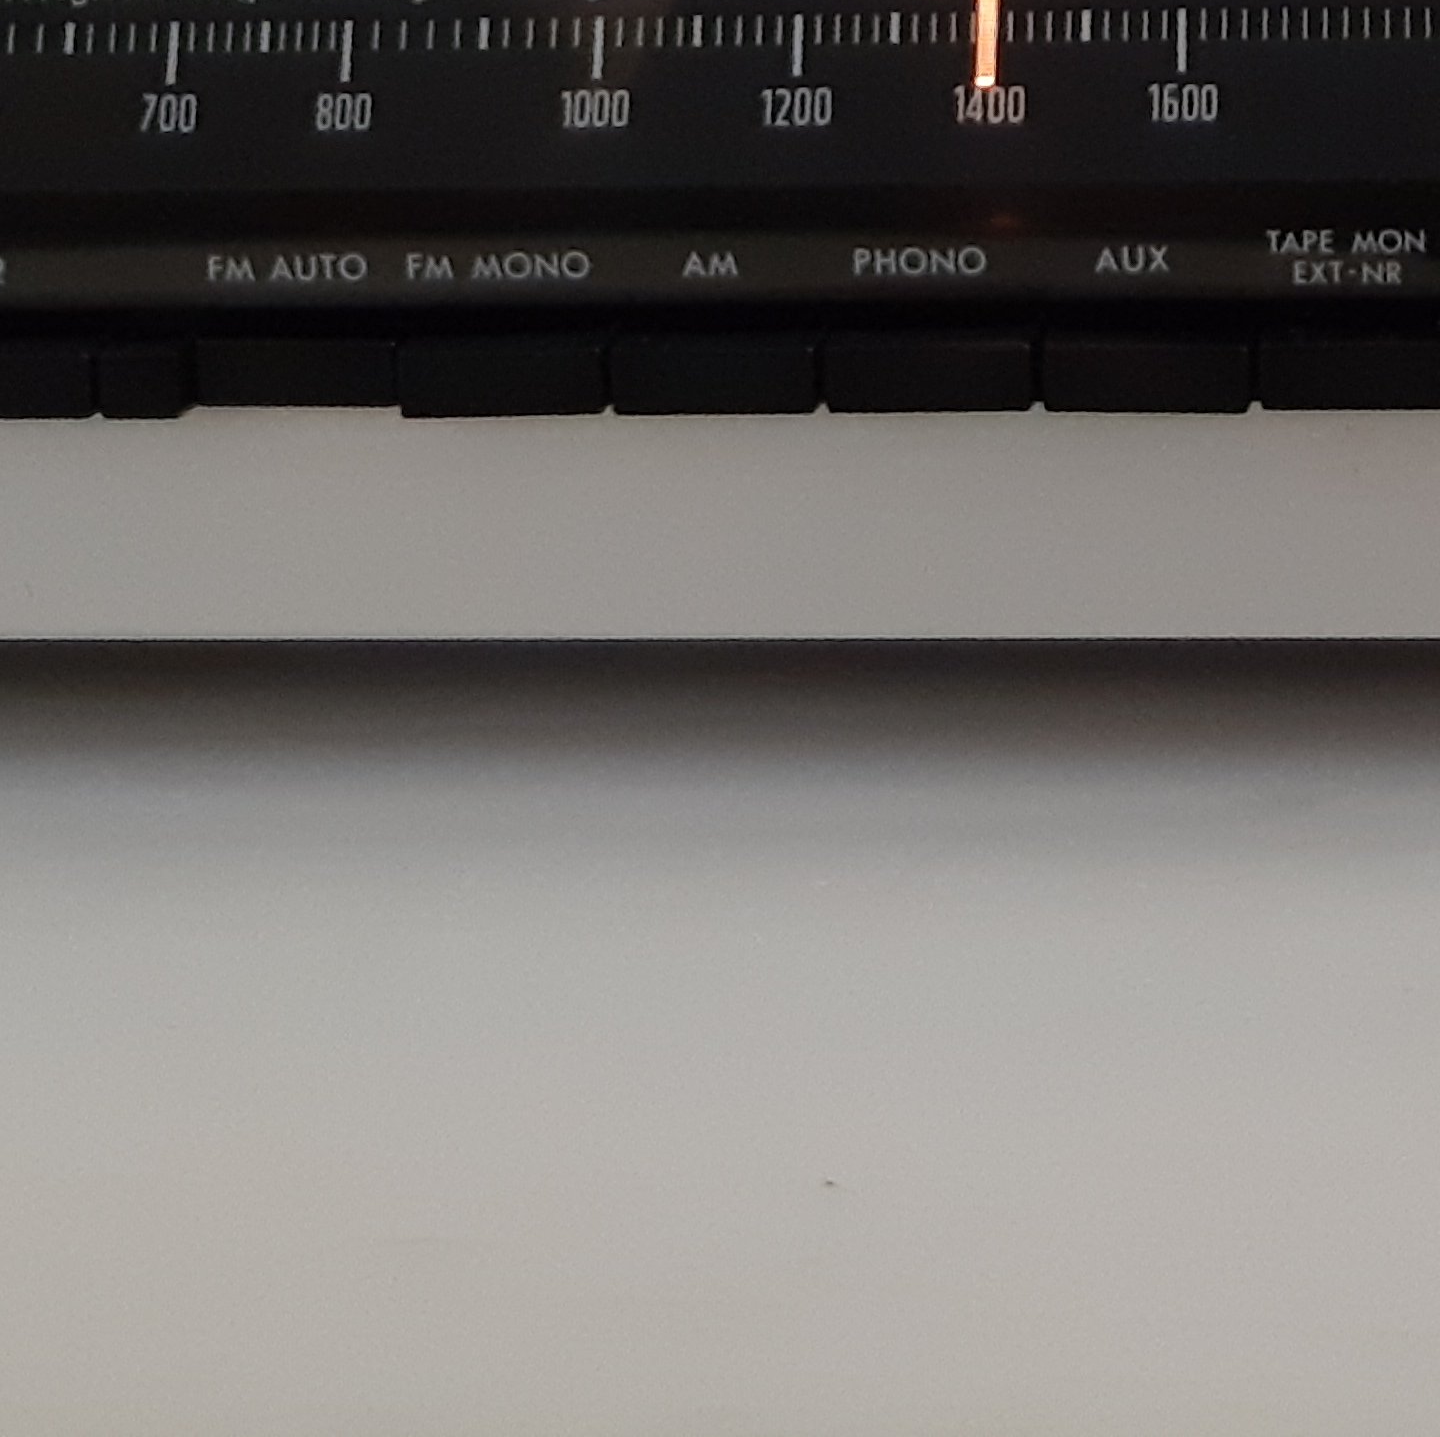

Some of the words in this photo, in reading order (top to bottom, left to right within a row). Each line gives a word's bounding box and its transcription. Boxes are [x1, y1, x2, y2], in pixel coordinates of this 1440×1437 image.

[140, 93, 198, 133] 700
[315, 92, 372, 131] 800
[561, 88, 630, 129] 1000
[761, 86, 832, 127] 1200
[954, 84, 1027, 123] 1400
[1148, 83, 1219, 123] 1600
[1266, 229, 1335, 255] TAPE
[1351, 228, 1426, 255] MON
[207, 255, 256, 282] FM
[269, 252, 368, 283] AUTO
[405, 253, 454, 280] FM
[471, 250, 590, 280] MONO
[682, 251, 739, 278] AM
[853, 246, 987, 277] PHONO
[1095, 244, 1169, 273] AUX
[1293, 260, 1401, 285] EXT-NR
